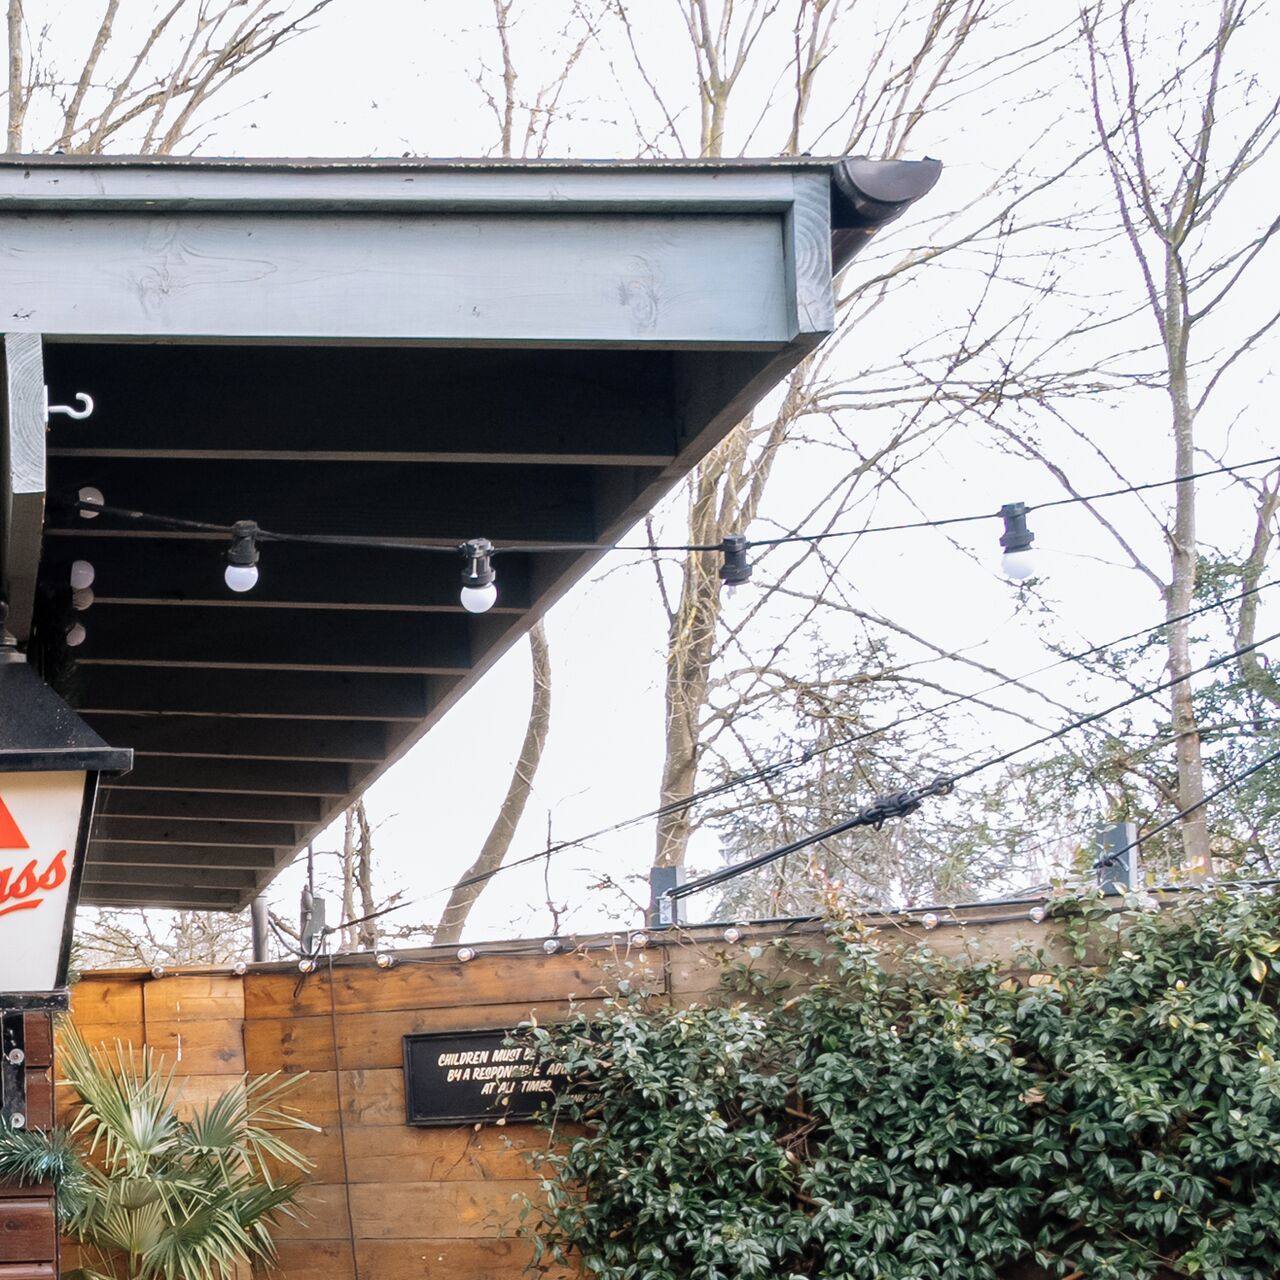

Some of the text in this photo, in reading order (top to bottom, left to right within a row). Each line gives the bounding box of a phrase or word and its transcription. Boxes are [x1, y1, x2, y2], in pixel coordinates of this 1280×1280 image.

[438, 1050, 489, 1067] CHILDREN
[492, 1048, 523, 1063] MUST
[447, 1068, 462, 1083] BY
[462, 1068, 471, 1081] A
[472, 1066, 541, 1081] RESPONBE
[481, 1082, 496, 1096] AT
[521, 1079, 553, 1094] TIMES
